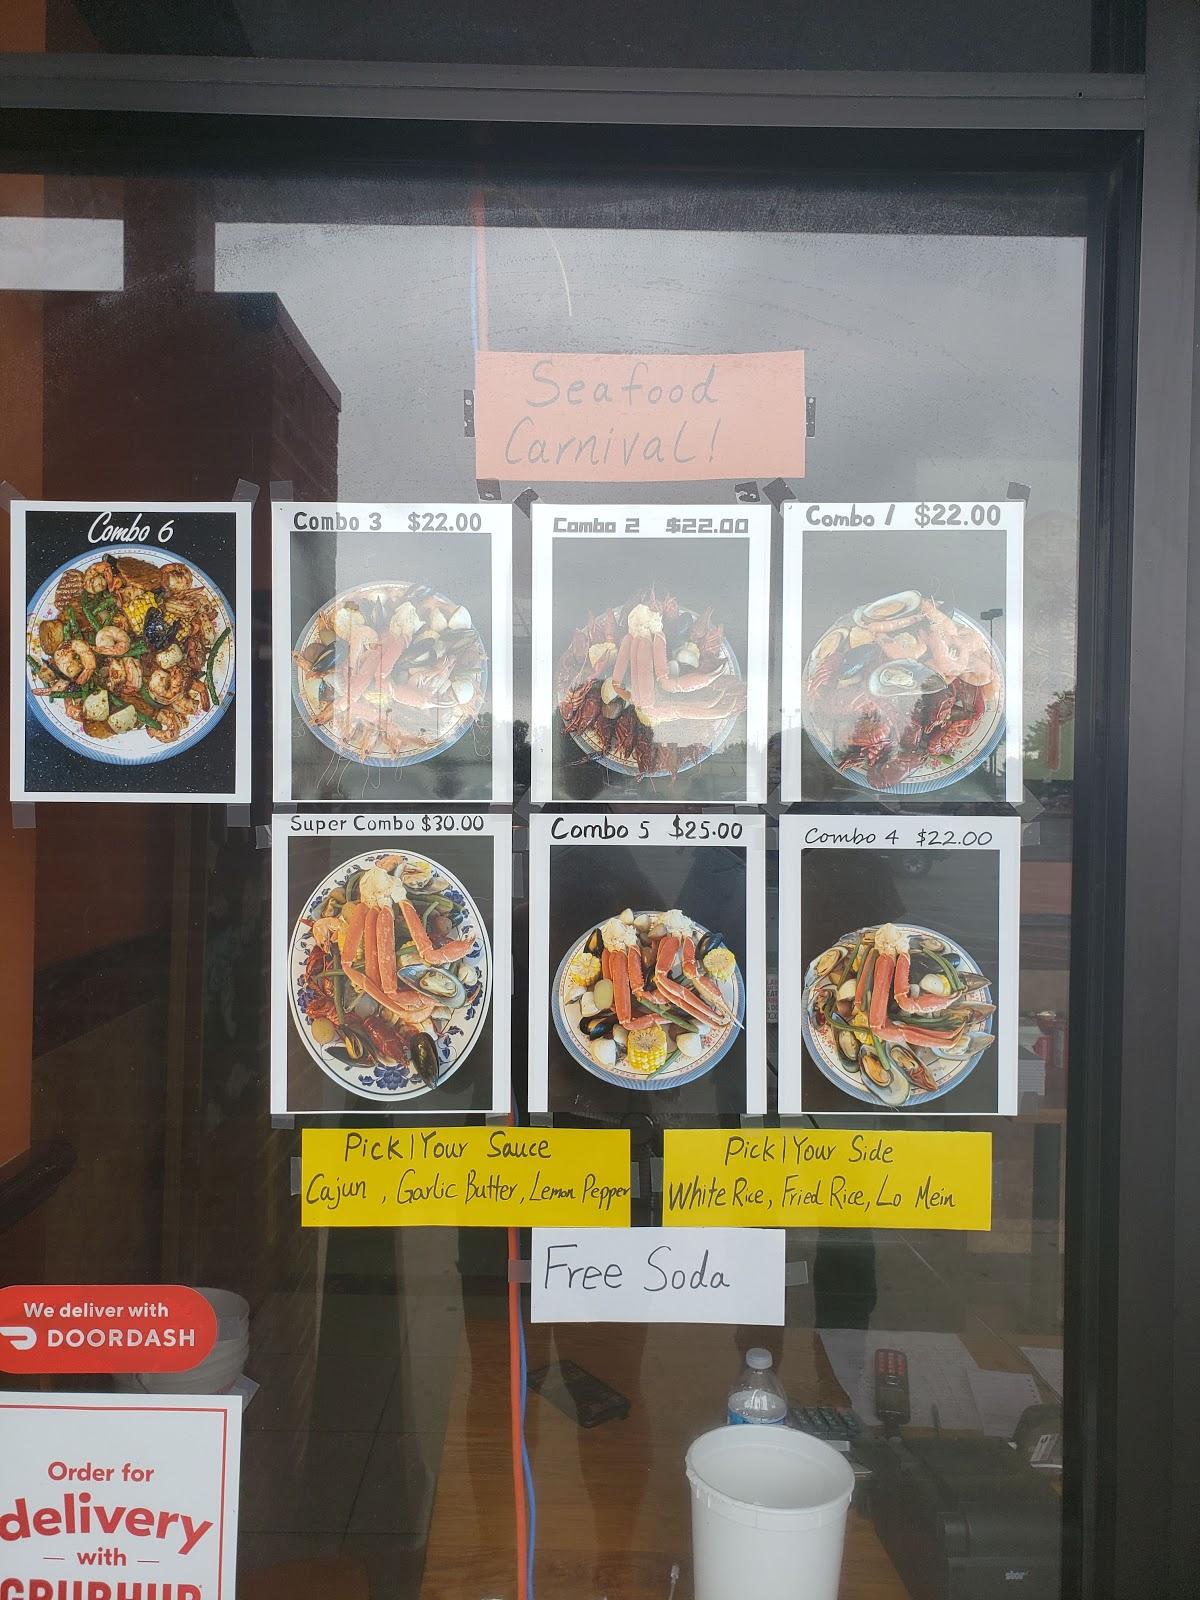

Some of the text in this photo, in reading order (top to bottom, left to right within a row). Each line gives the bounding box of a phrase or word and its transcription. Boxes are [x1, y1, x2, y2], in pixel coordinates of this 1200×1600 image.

[525, 359, 719, 407] Seafood
[293, 511, 482, 532] Combo 3 $22.00
[552, 517, 749, 534] Combo 2 $22.00
[806, 505, 875, 527] Combo
[914, 503, 1002, 527] $22.00
[87, 512, 174, 544] Combo 6
[290, 814, 485, 835] Super Combo $30.00
[551, 815, 744, 841] Combo 5 $25.00
[804, 827, 993, 846] Combo 4 $22.00
[344, 1132, 403, 1162] Pick
[486, 1130, 552, 1159] Sauce
[724, 1136, 775, 1165] Pick
[848, 1135, 894, 1163] Side
[396, 1168, 459, 1205] Garlic
[669, 1175, 727, 1211] White
[781, 1174, 823, 1207] Fried
[876, 1174, 902, 1207] Lo
[915, 1175, 955, 1209] Mein
[544, 1244, 730, 1292] Free Soda
[23, 1302, 169, 1318] We deliver with
[47, 1328, 196, 1348] DOORDASH
[47, 1461, 154, 1482] Order for
[0, 1492, 214, 1556] delivery
[76, 1547, 127, 1566] with
